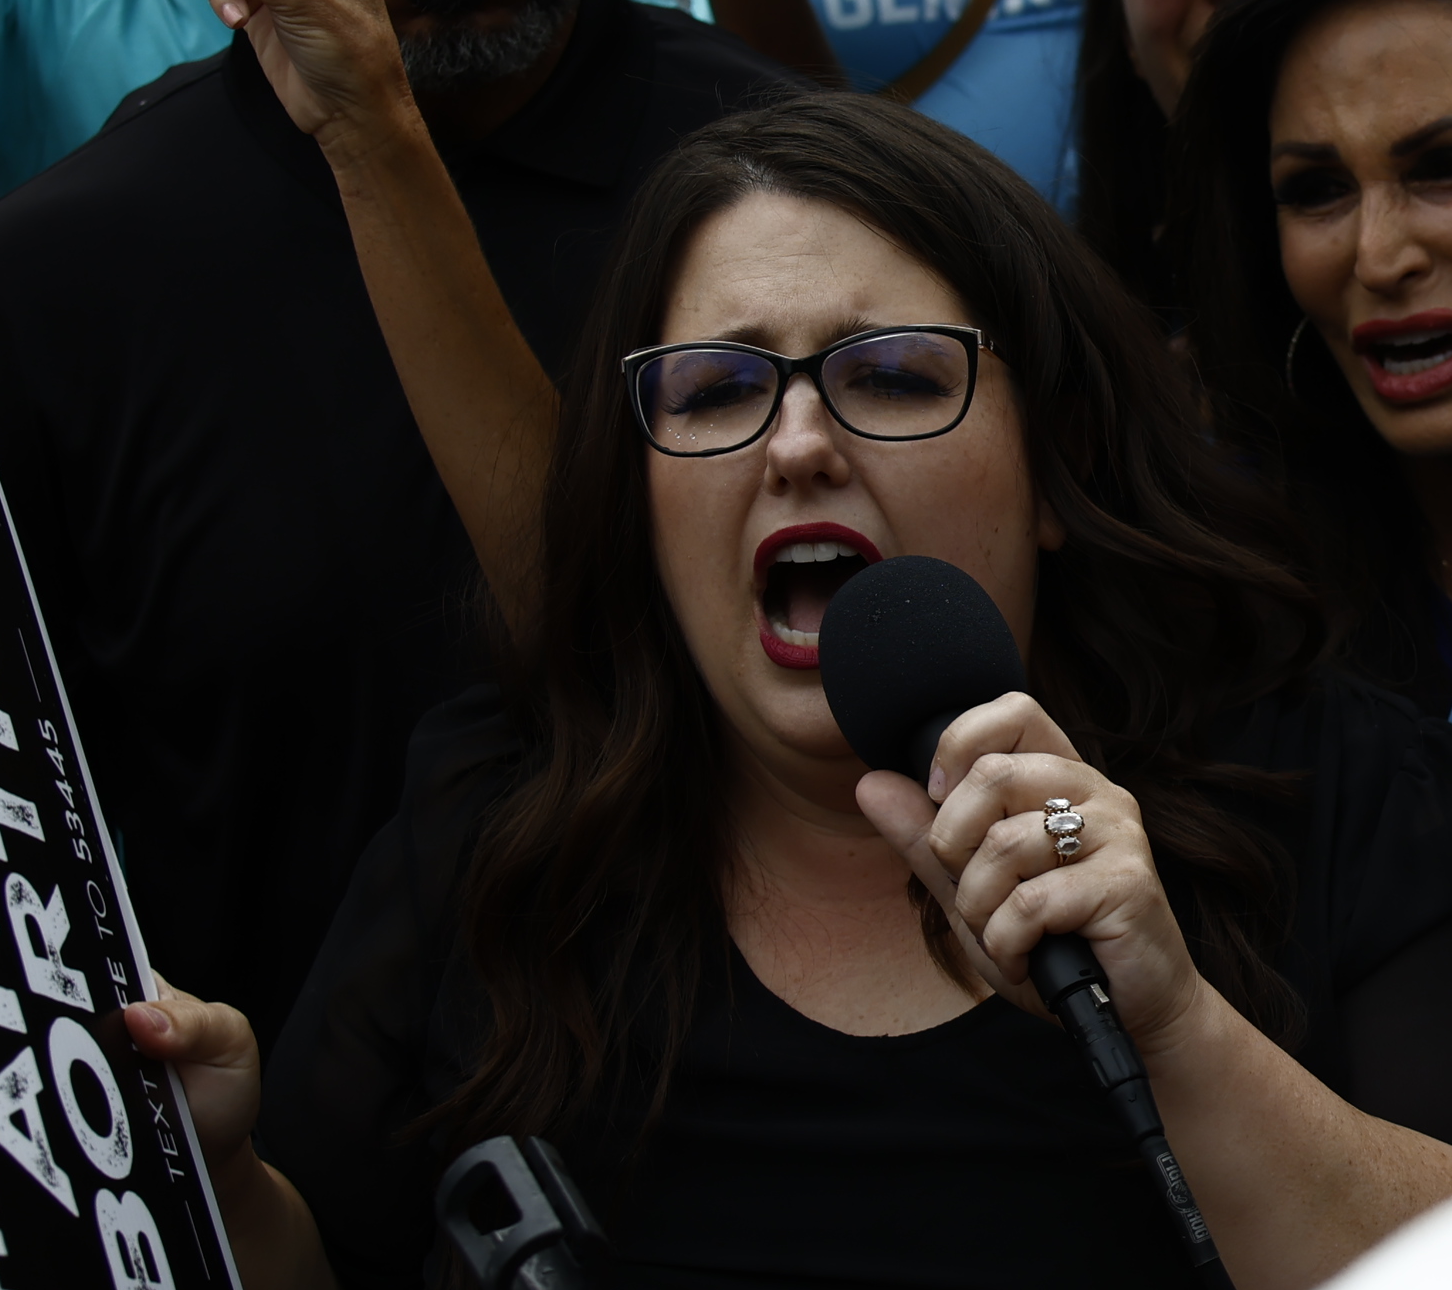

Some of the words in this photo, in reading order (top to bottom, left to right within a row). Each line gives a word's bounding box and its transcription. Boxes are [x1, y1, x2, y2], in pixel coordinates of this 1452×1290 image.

[37, 717, 93, 864] 53445
[85, 878, 115, 941] TO
[139, 1069, 186, 1182] TEXT
